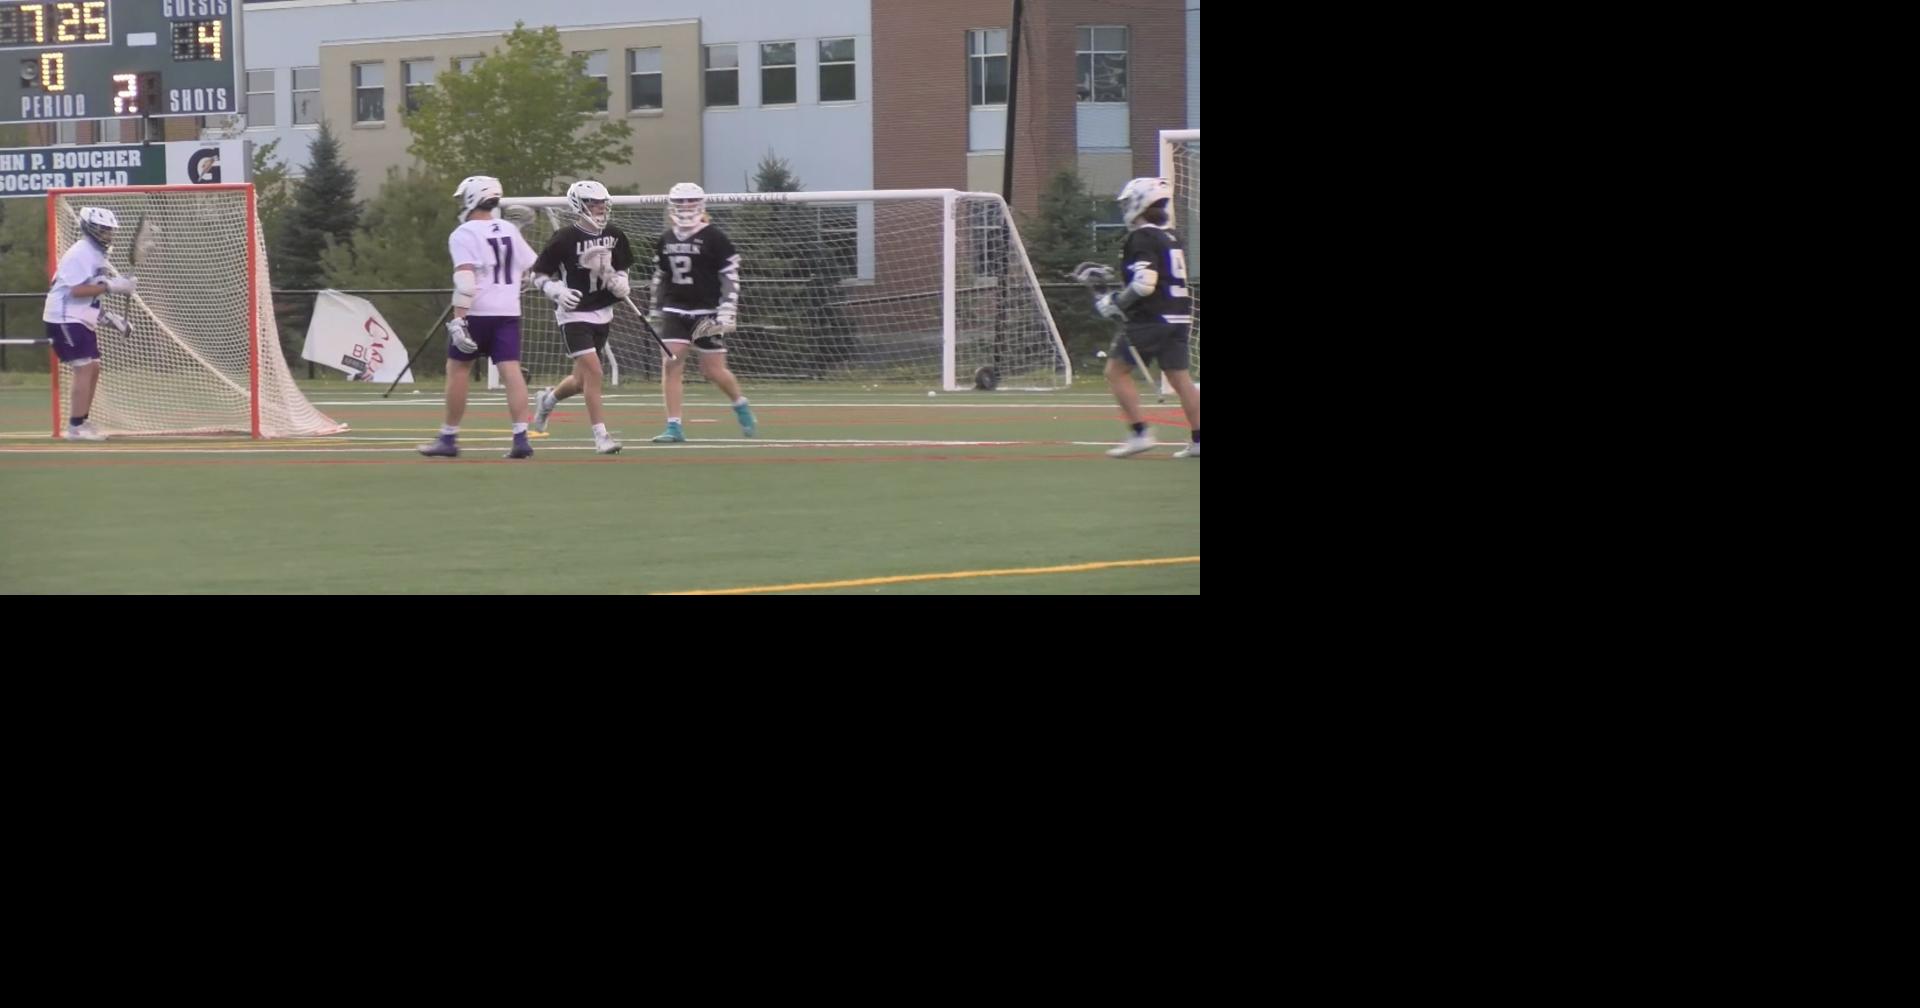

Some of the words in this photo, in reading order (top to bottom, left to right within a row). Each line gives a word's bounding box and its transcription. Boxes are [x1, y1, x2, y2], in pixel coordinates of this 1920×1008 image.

[41, 52, 64, 91] 0
[21, 94, 85, 118] PERIOD
[169, 88, 227, 112] SHOTS
[31, 153, 46, 170] P.
[52, 150, 142, 170] BOUCHER
[72, 170, 129, 189] FIELD
[487, 236, 513, 285] 11
